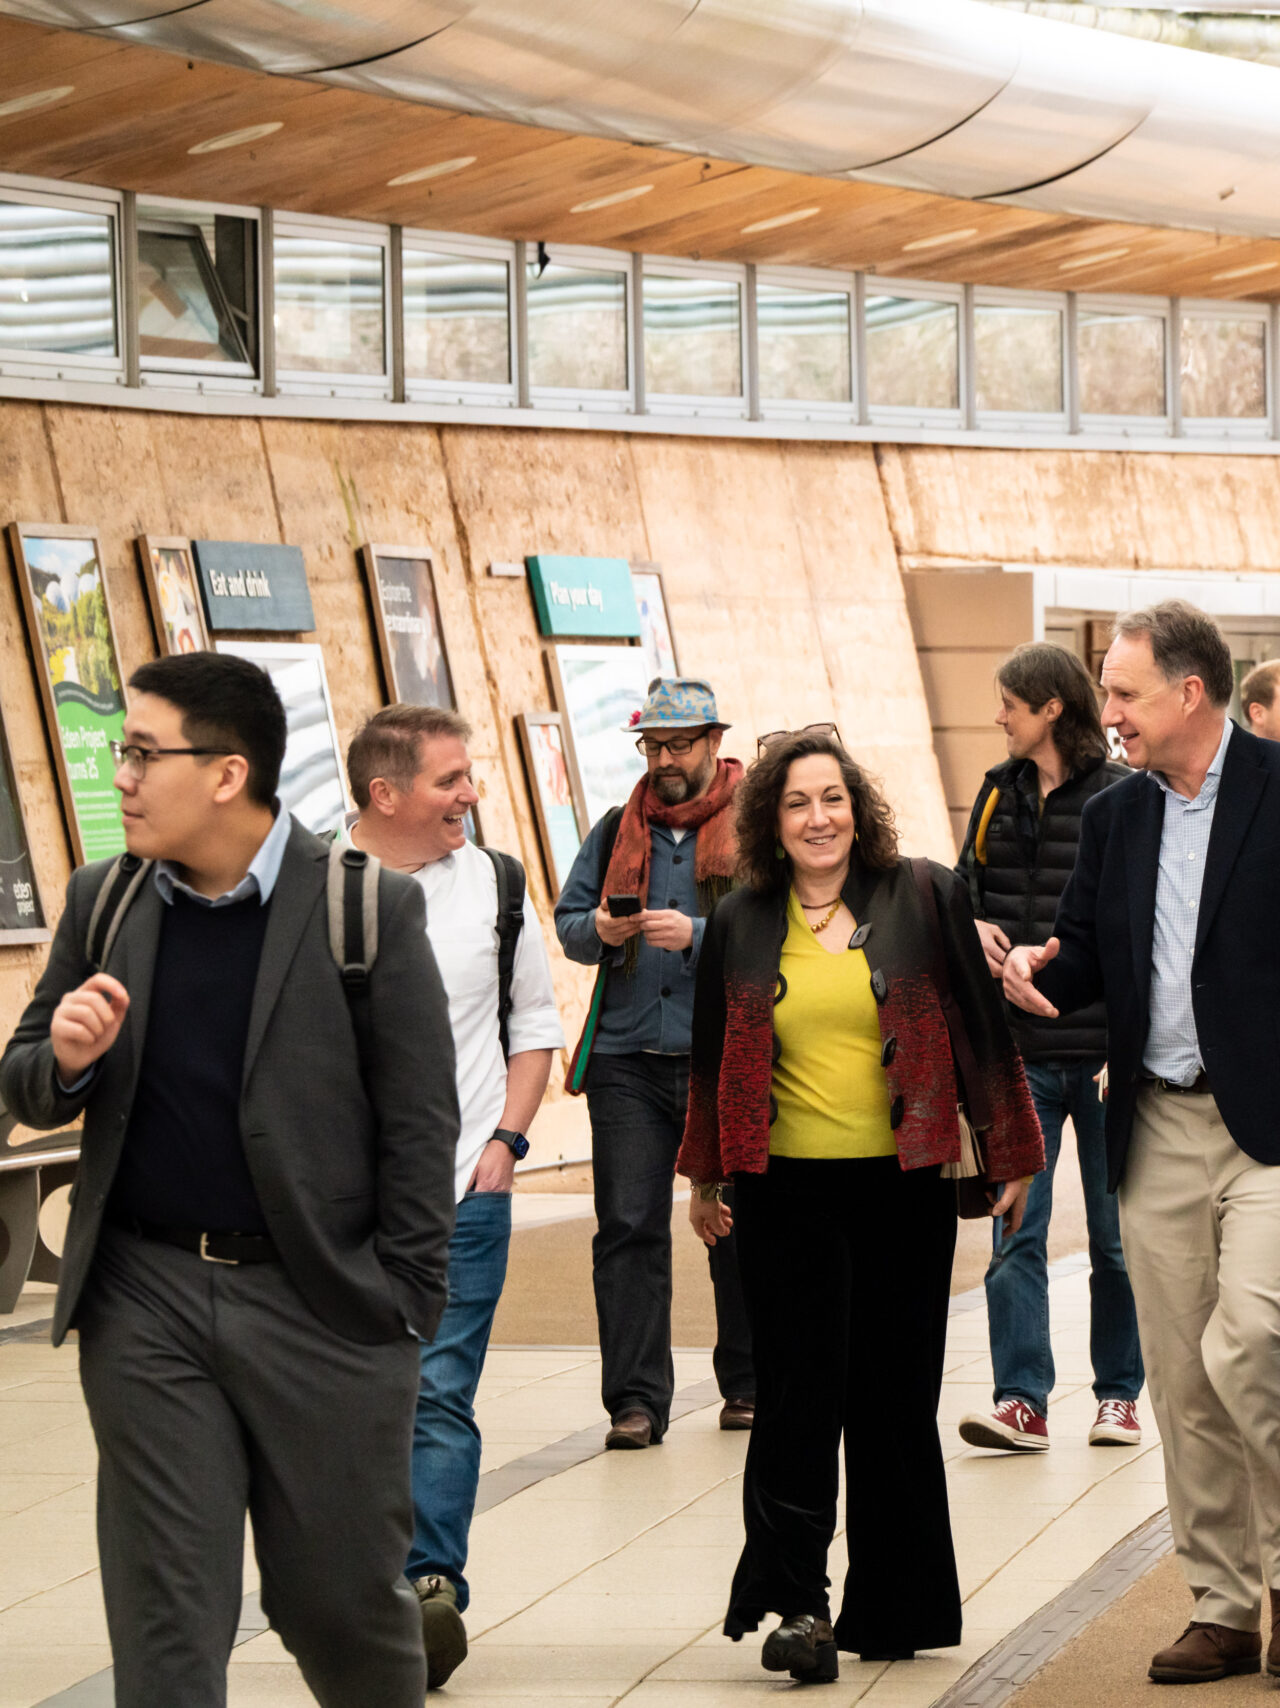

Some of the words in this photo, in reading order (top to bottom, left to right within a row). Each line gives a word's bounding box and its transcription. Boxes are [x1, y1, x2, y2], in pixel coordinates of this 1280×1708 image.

[209, 568, 229, 597] Eat
[228, 569, 248, 597] and
[246, 569, 272, 598] drink
[549, 580, 569, 606] Plan
[568, 587, 588, 612] your
[587, 581, 604, 613] day
[79, 725, 108, 755] Project
